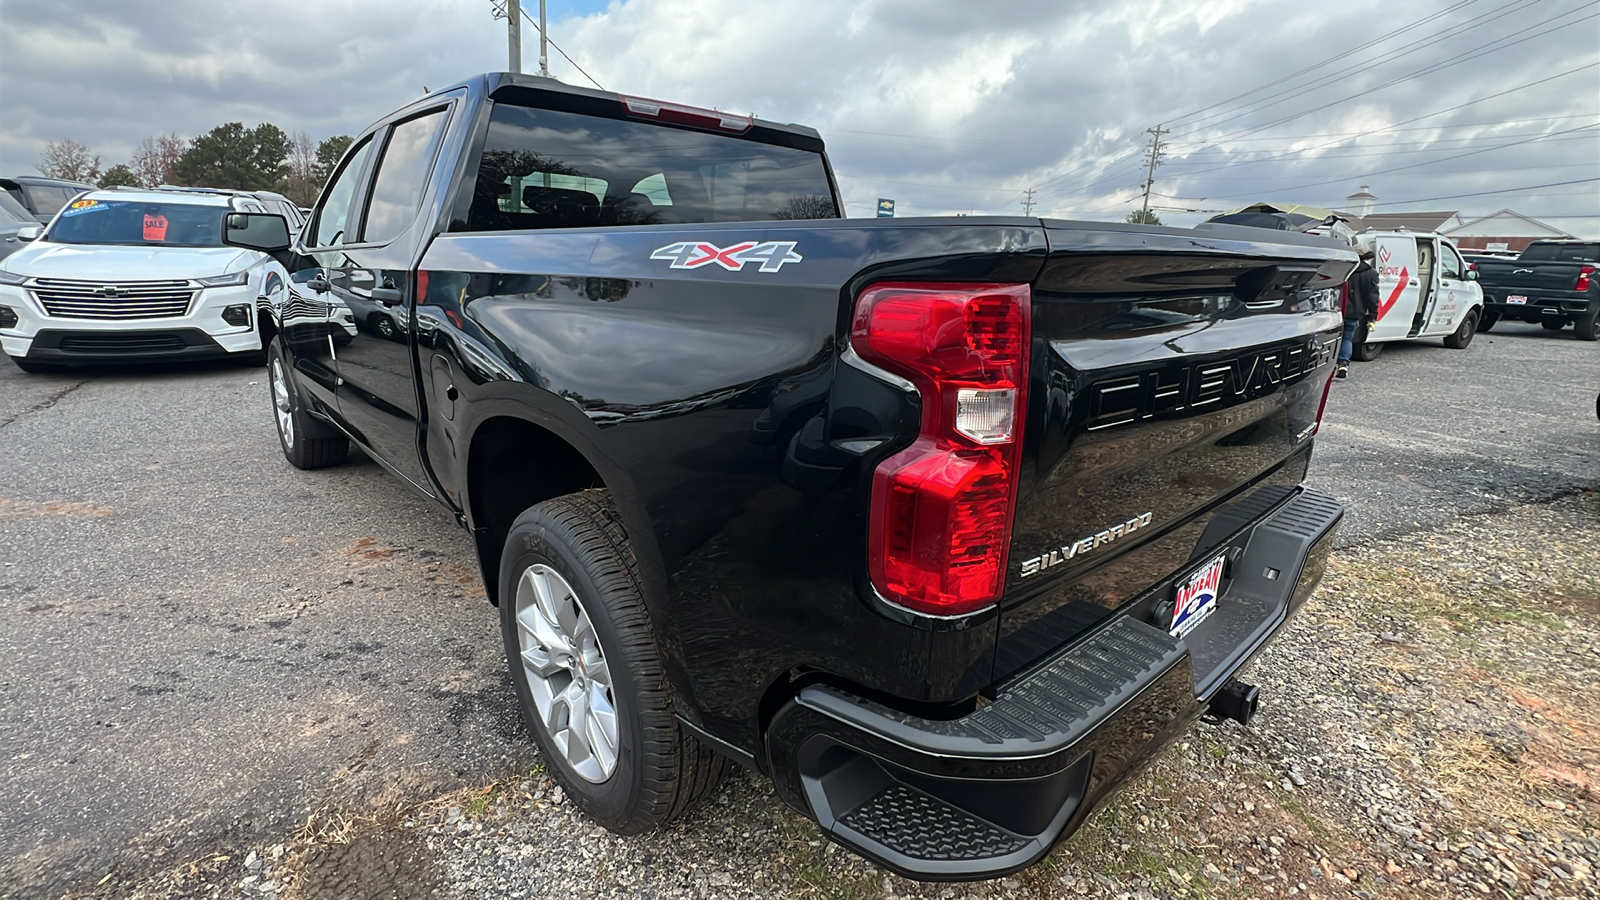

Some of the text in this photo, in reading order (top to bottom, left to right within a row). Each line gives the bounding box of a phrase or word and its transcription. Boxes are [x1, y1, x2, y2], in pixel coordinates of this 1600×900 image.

[63, 203, 106, 215] CERTIFIED
[145, 220, 164, 228] SALE
[1087, 336, 1342, 430] CHEVROLET
[1020, 511, 1152, 577] SILVERADO
